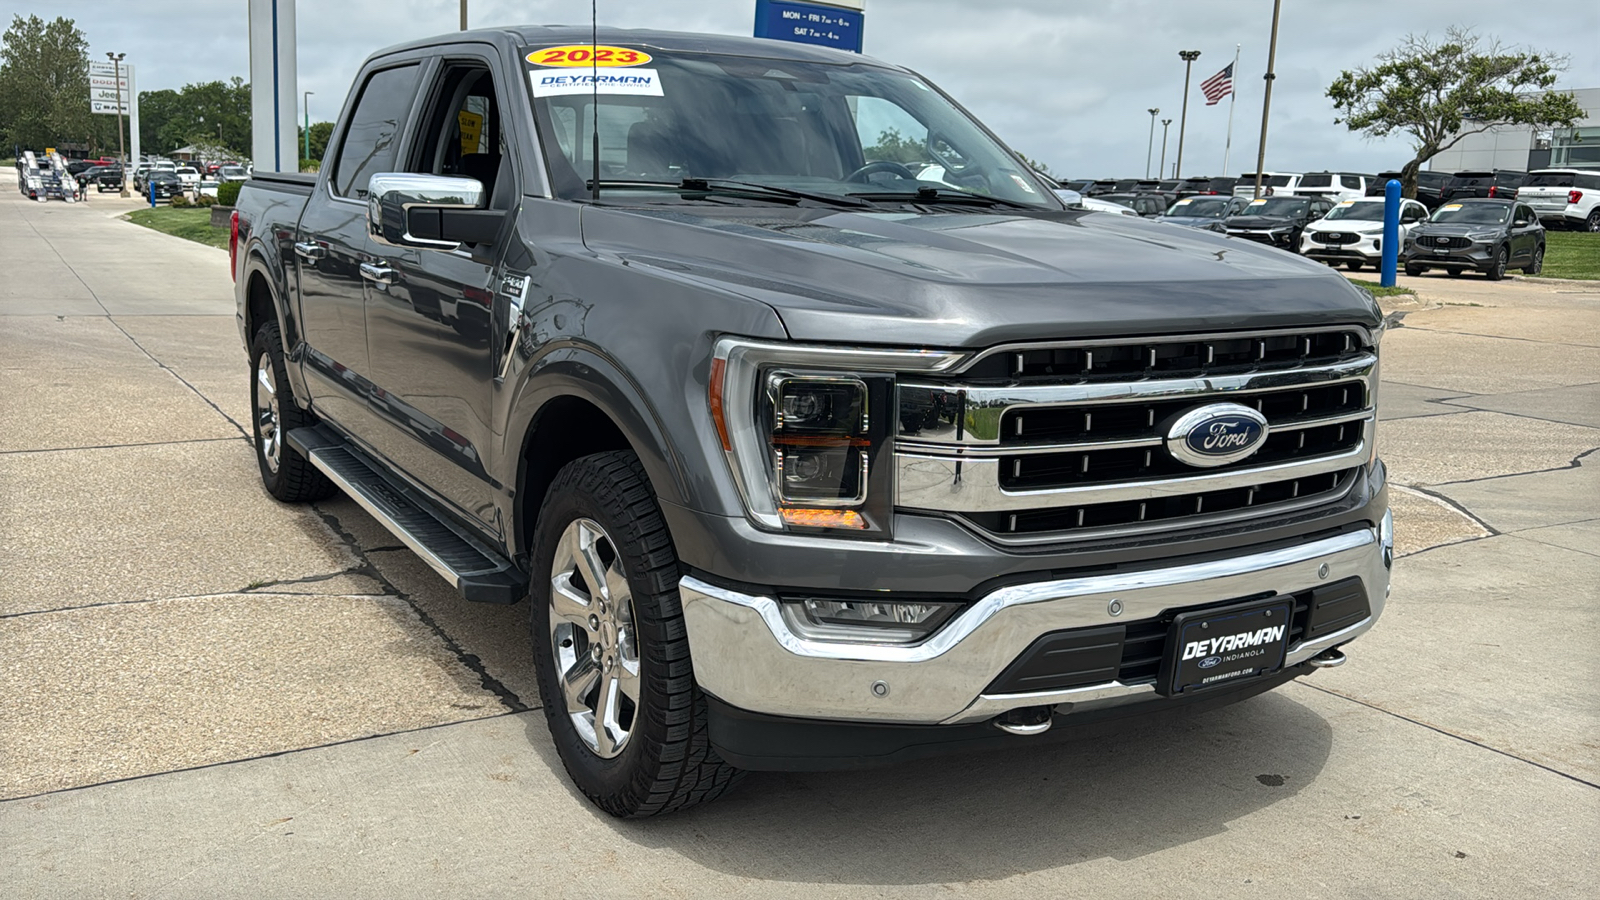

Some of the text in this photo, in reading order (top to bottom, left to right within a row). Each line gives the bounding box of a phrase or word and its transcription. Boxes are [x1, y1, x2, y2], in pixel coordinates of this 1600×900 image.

[782, 10, 800, 20] MON
[808, 13, 820, 22] FRI
[794, 26, 808, 36] SAT
[541, 50, 639, 63] 2023
[540, 75, 652, 85] DEYARMAN
[1204, 421, 1250, 450] Ford
[1182, 624, 1286, 661] DEYARMAN
[1202, 648, 1266, 668] Ford INDIANOLA
[1202, 668, 1254, 684] DEYARMANFORD.COM
